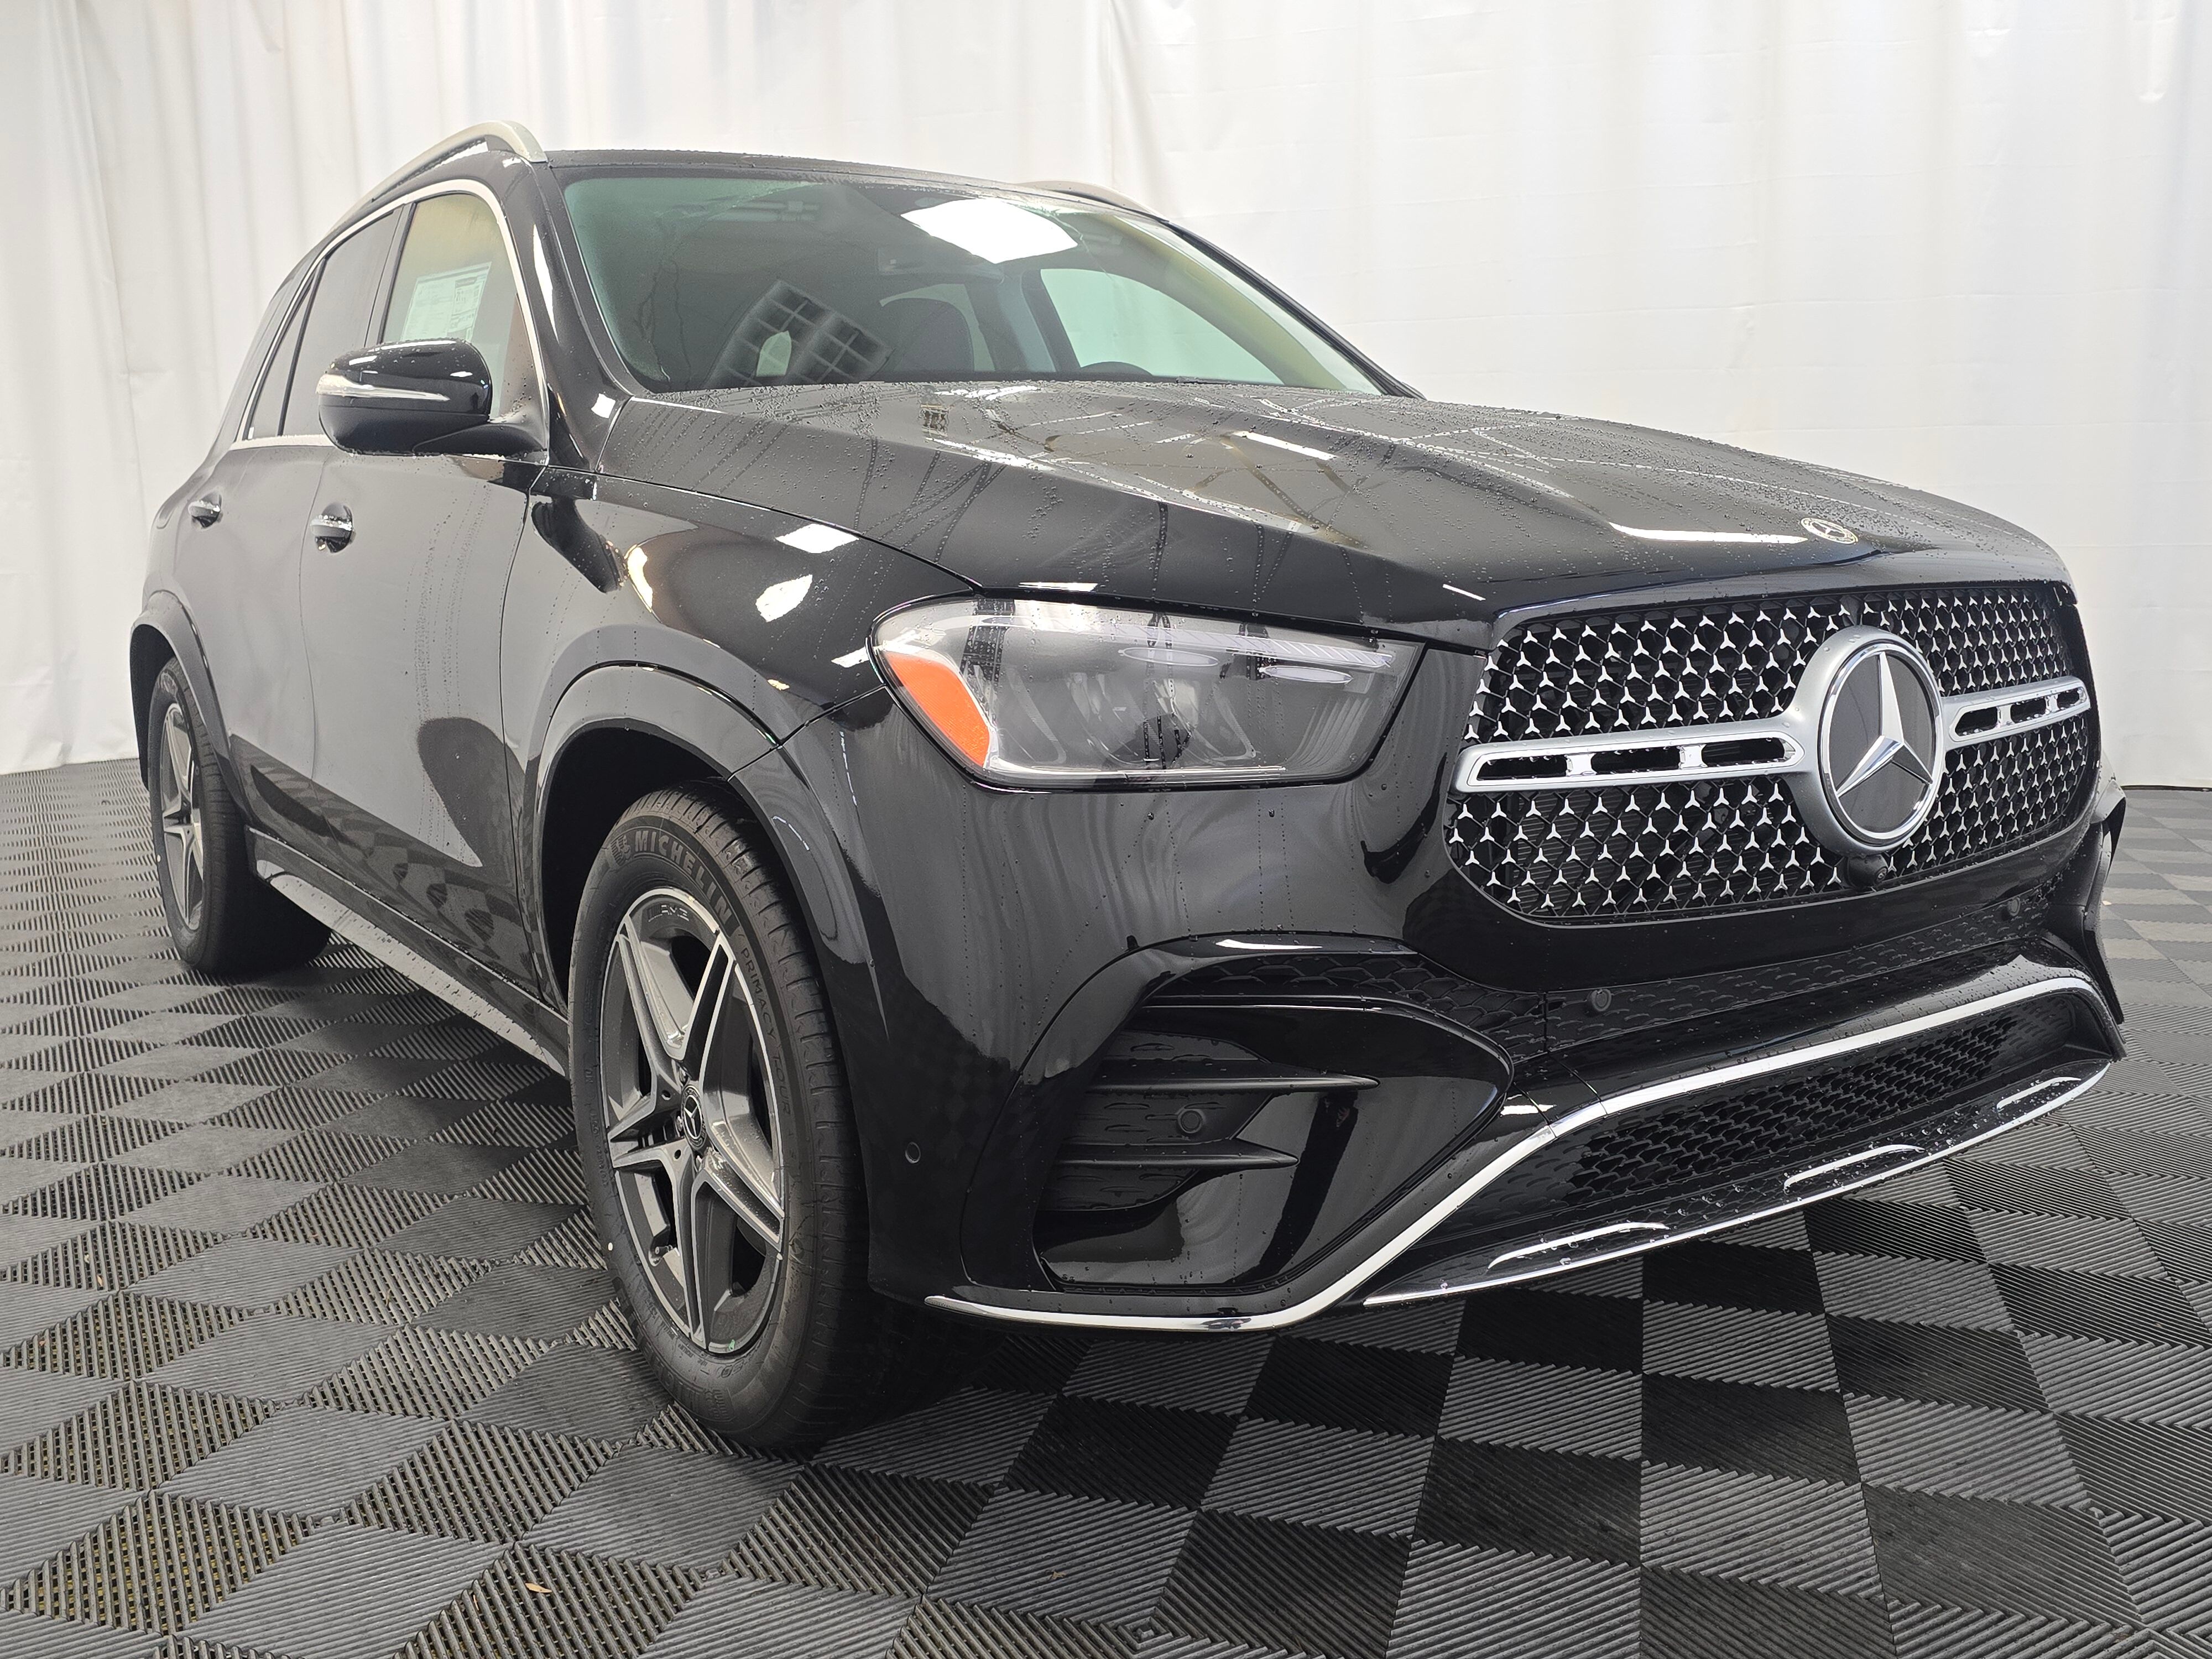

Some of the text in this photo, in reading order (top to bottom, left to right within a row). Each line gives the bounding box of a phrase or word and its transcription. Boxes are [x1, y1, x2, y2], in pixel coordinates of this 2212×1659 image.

[635, 830, 733, 925] MICHELIN
[741, 948, 791, 1115] PRIMACY TOUR
